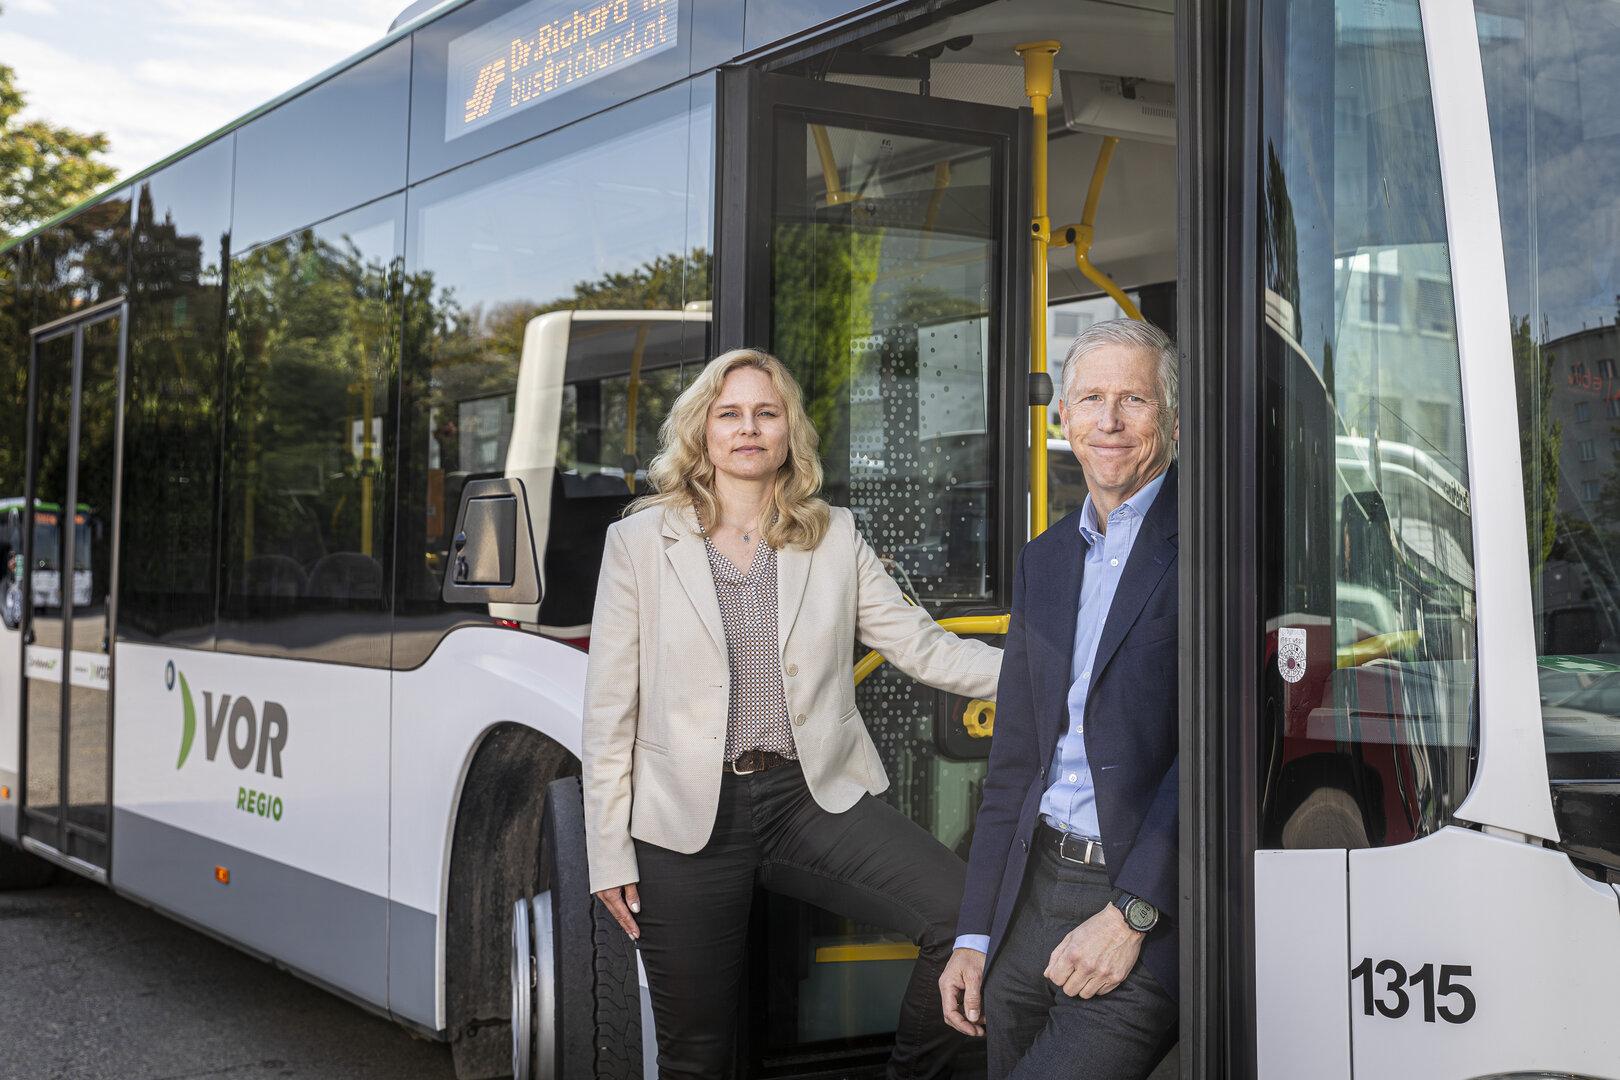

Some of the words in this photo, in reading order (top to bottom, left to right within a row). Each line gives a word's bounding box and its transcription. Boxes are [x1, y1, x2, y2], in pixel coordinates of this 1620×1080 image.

[202, 690, 288, 778] VOR
[236, 786, 283, 821] REGIO
[1351, 957, 1476, 1024] 1315
